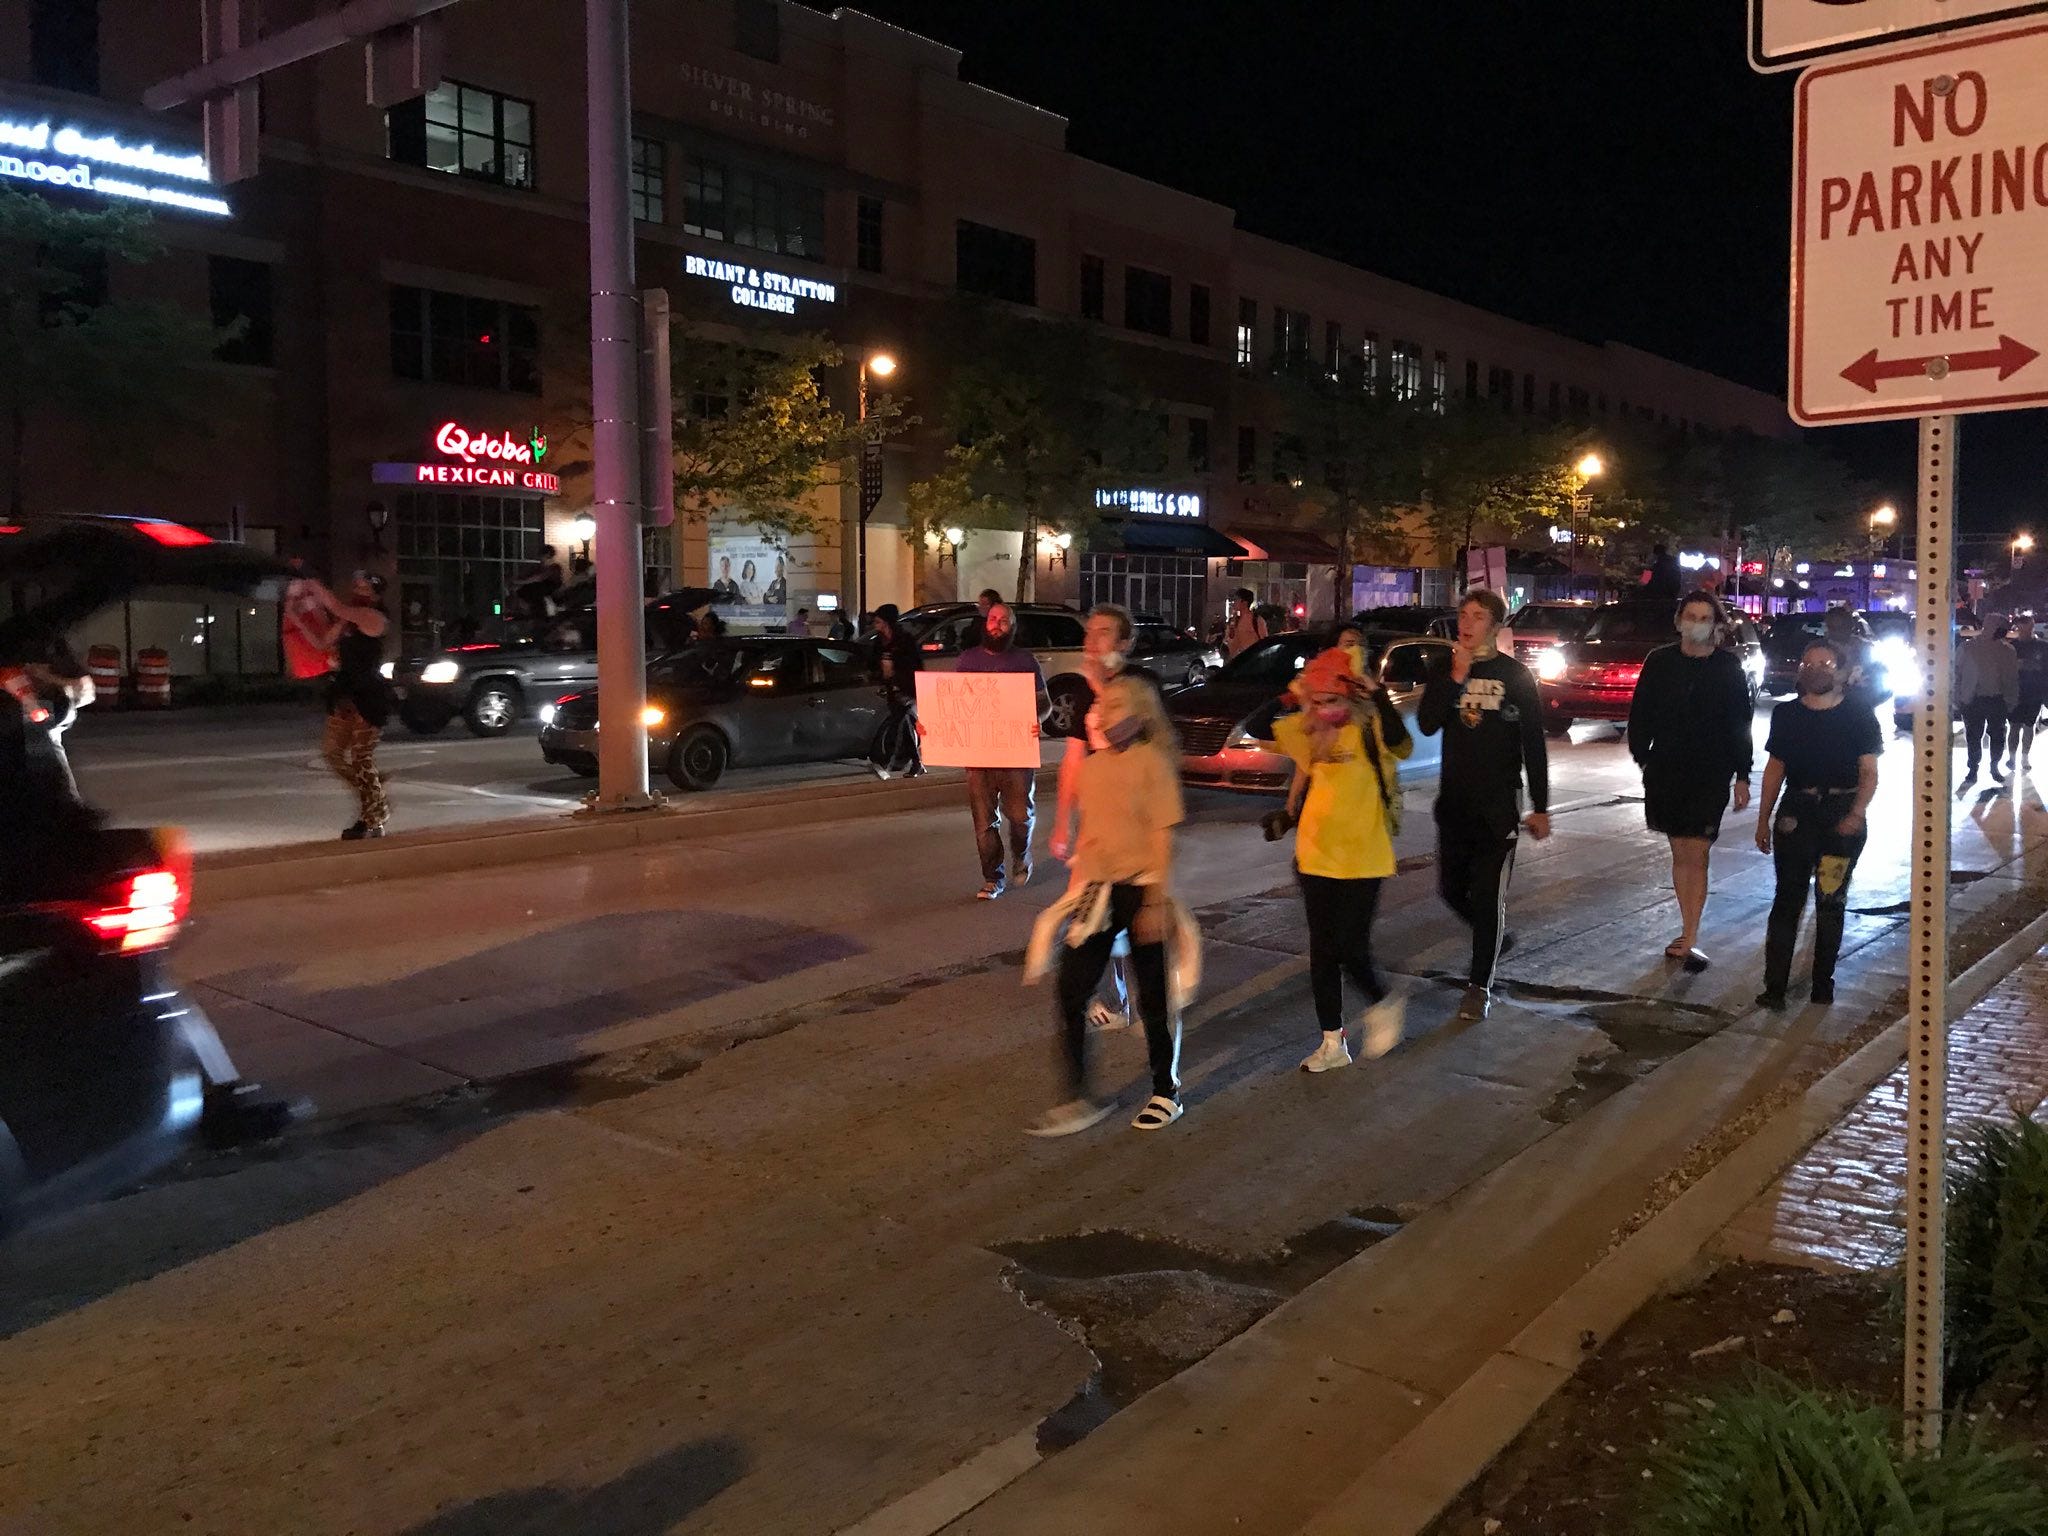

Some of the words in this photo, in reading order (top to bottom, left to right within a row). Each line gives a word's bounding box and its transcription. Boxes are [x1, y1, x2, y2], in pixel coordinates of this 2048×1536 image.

[681, 62, 751, 101] SILVER
[761, 88, 834, 127] SPRING
[1893, 70, 1987, 147] NO
[685, 255, 745, 284] BRYANT
[748, 268, 760, 287] &
[763, 271, 835, 302] STRATTON
[1891, 232, 1984, 284] ANY
[731, 285, 795, 314] COLLEGE
[1885, 287, 1994, 338] TIME
[436, 422, 531, 464] Qdoba
[418, 465, 515, 486] MEXICAN
